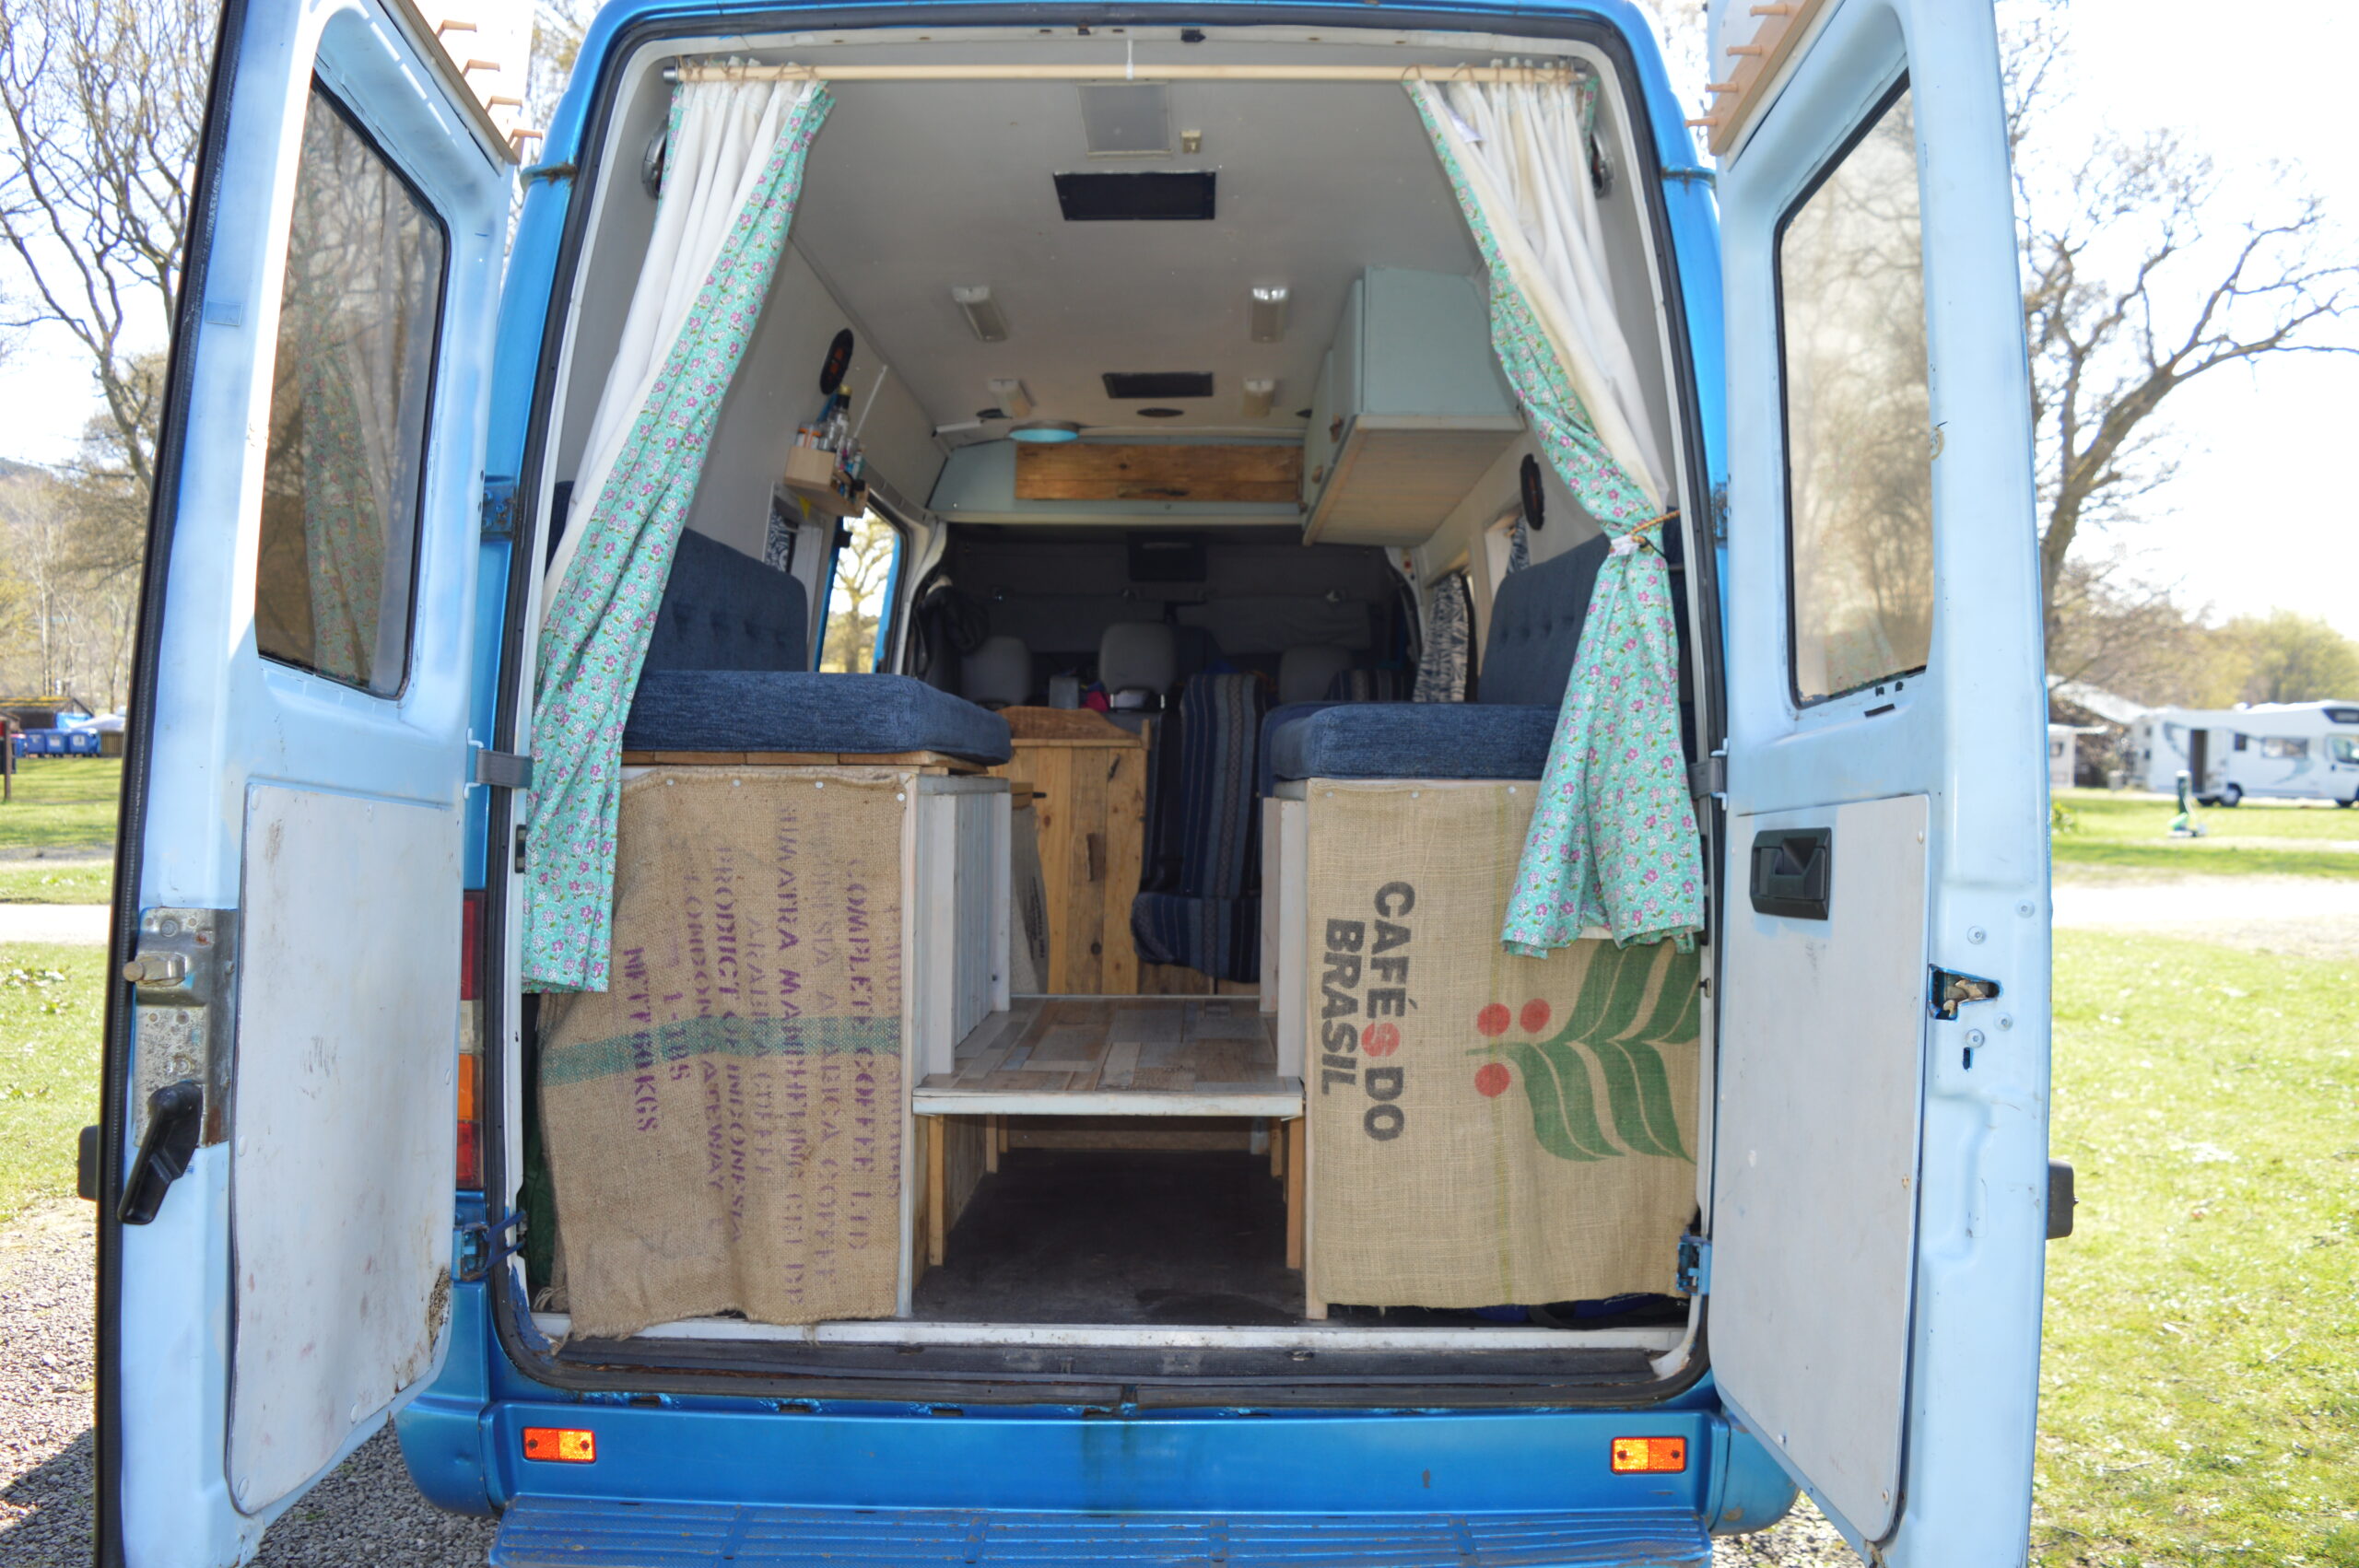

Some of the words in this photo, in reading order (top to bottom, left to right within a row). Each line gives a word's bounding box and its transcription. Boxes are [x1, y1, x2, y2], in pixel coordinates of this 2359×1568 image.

[713, 846, 740, 1001] PRODUCT
[777, 802, 799, 951] SUMATRA
[846, 858, 874, 1034] COMPLETE
[623, 945, 651, 1024] NETT
[684, 872, 712, 1019] LONDON
[699, 1030, 725, 1191] GATEWAY
[722, 1012, 737, 1048] OF
[1320, 918, 1366, 1095] BRASIL
[1361, 881, 1418, 1057] CAFÉS
[816, 991, 841, 1142] ARABICA
[851, 1045, 875, 1173] COFFEE
[1363, 1066, 1405, 1141] DO
[726, 1064, 745, 1244] INDONESIA
[846, 1190, 872, 1250] LTD
